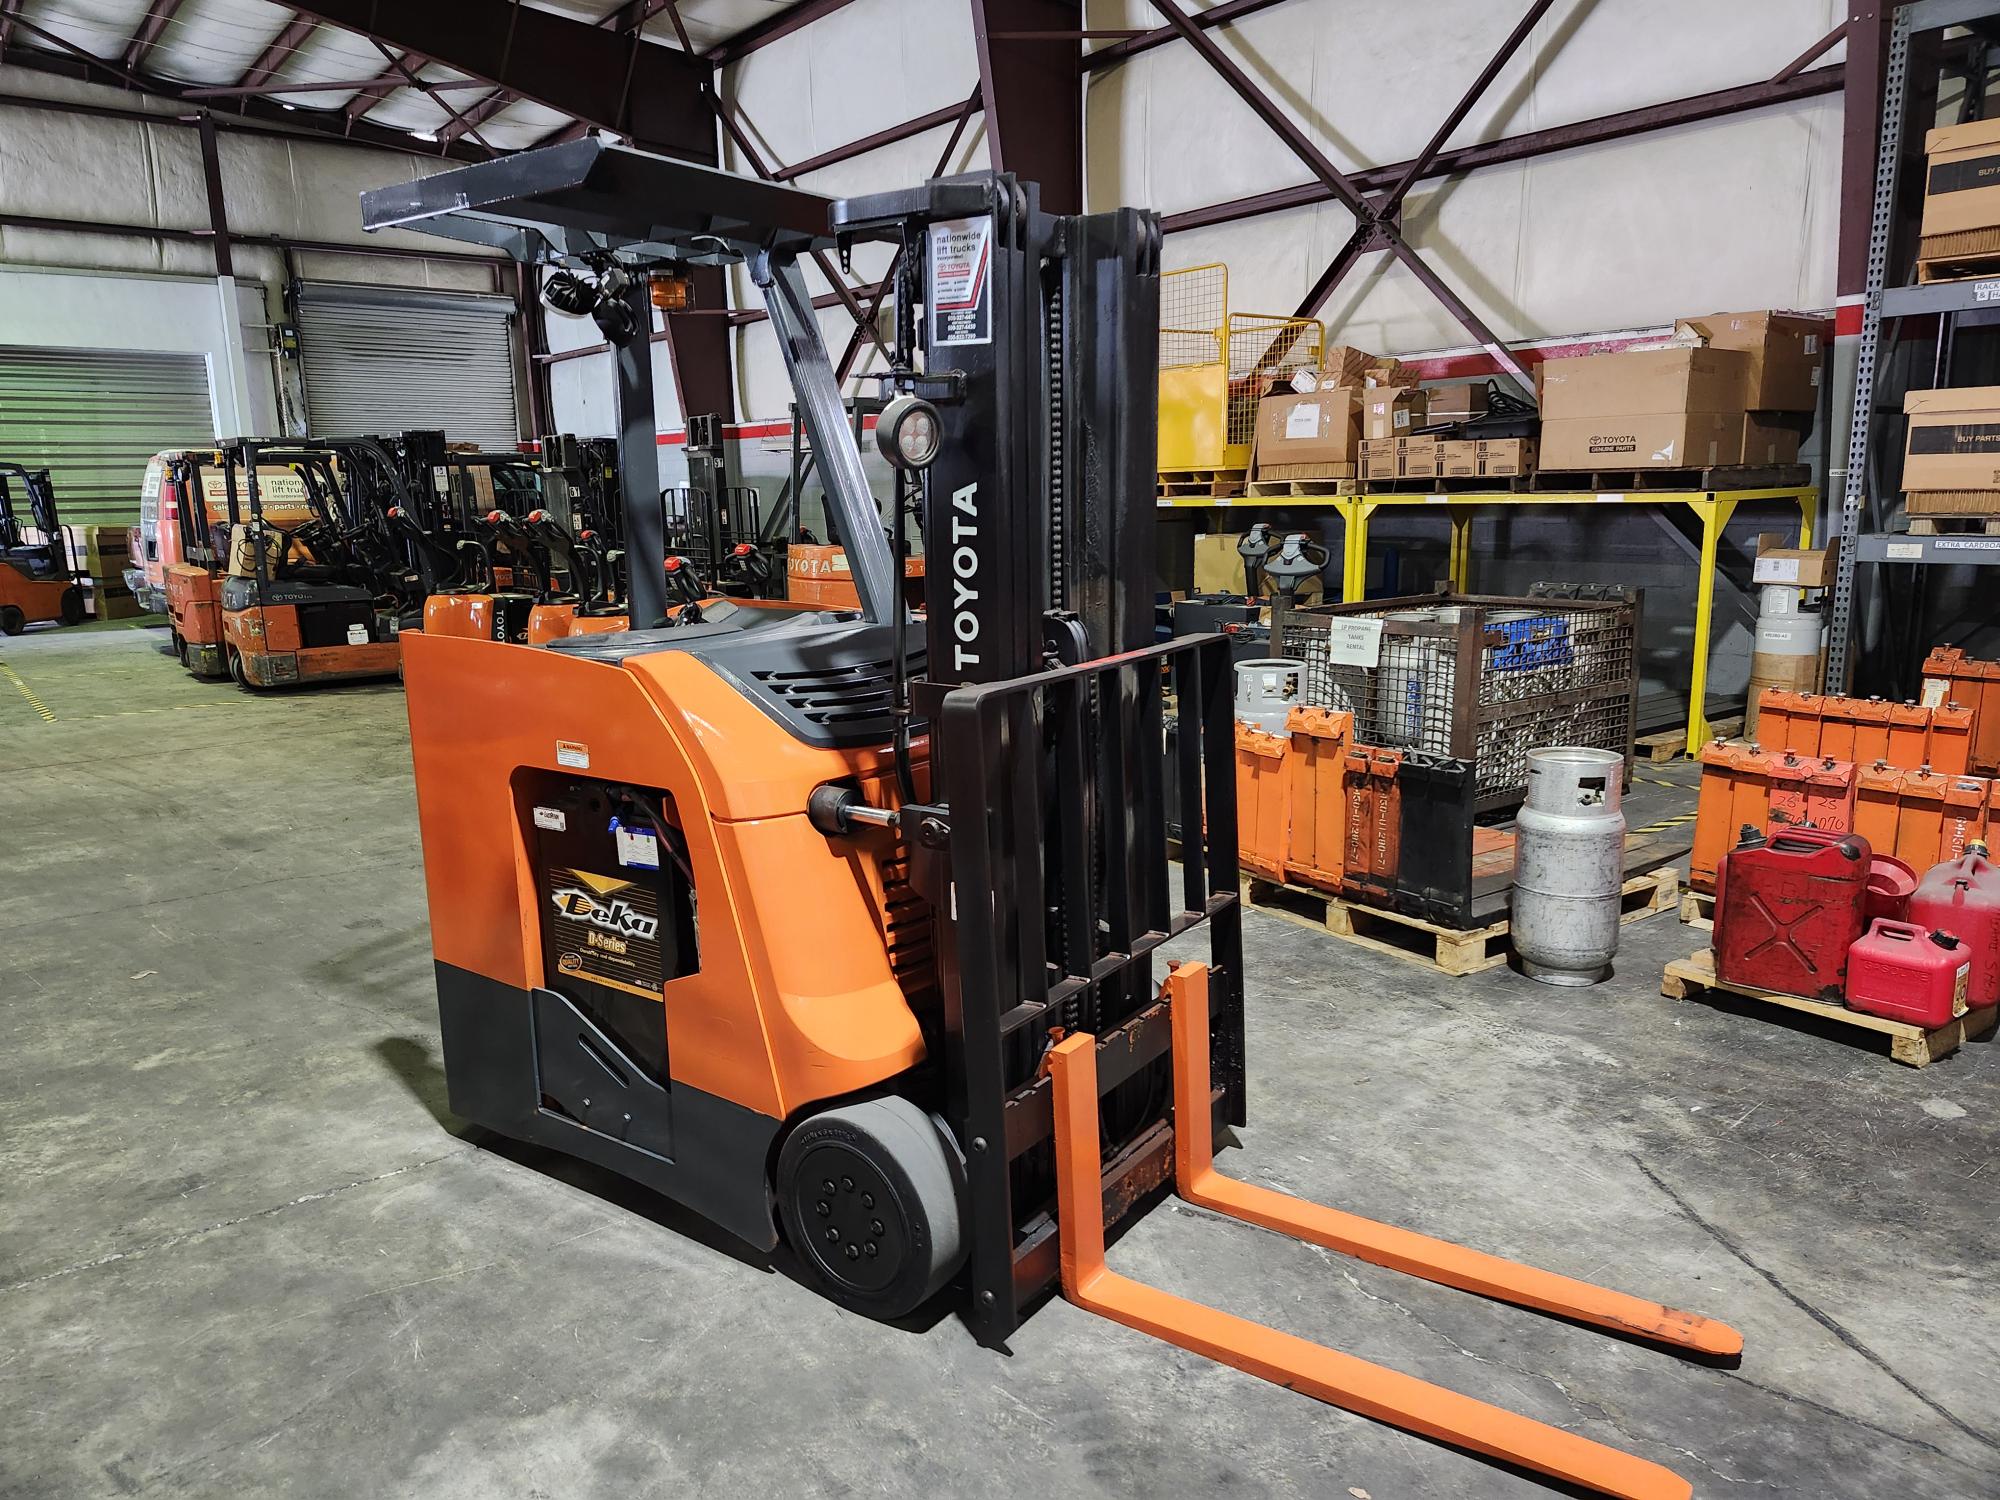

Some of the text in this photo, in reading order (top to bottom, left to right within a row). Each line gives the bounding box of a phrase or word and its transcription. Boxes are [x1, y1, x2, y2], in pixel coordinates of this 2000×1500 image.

[1978, 167, 1996, 177] BUY
[936, 231, 981, 245] nationwide
[936, 243, 976, 255] lift trucks
[1602, 435, 1637, 444] TOYOTA
[1957, 434, 2000, 443] BUY PARTS
[272, 486, 285, 494] lift
[274, 503, 295, 512] parts
[952, 482, 979, 671] TOYOTA
[1347, 633, 1365, 641] TANKS
[1345, 643, 1366, 651] RENTAL
[556, 892, 655, 935] Deka
[587, 929, 628, 955] D-Series
[1863, 960, 1931, 982] GASOLINE
